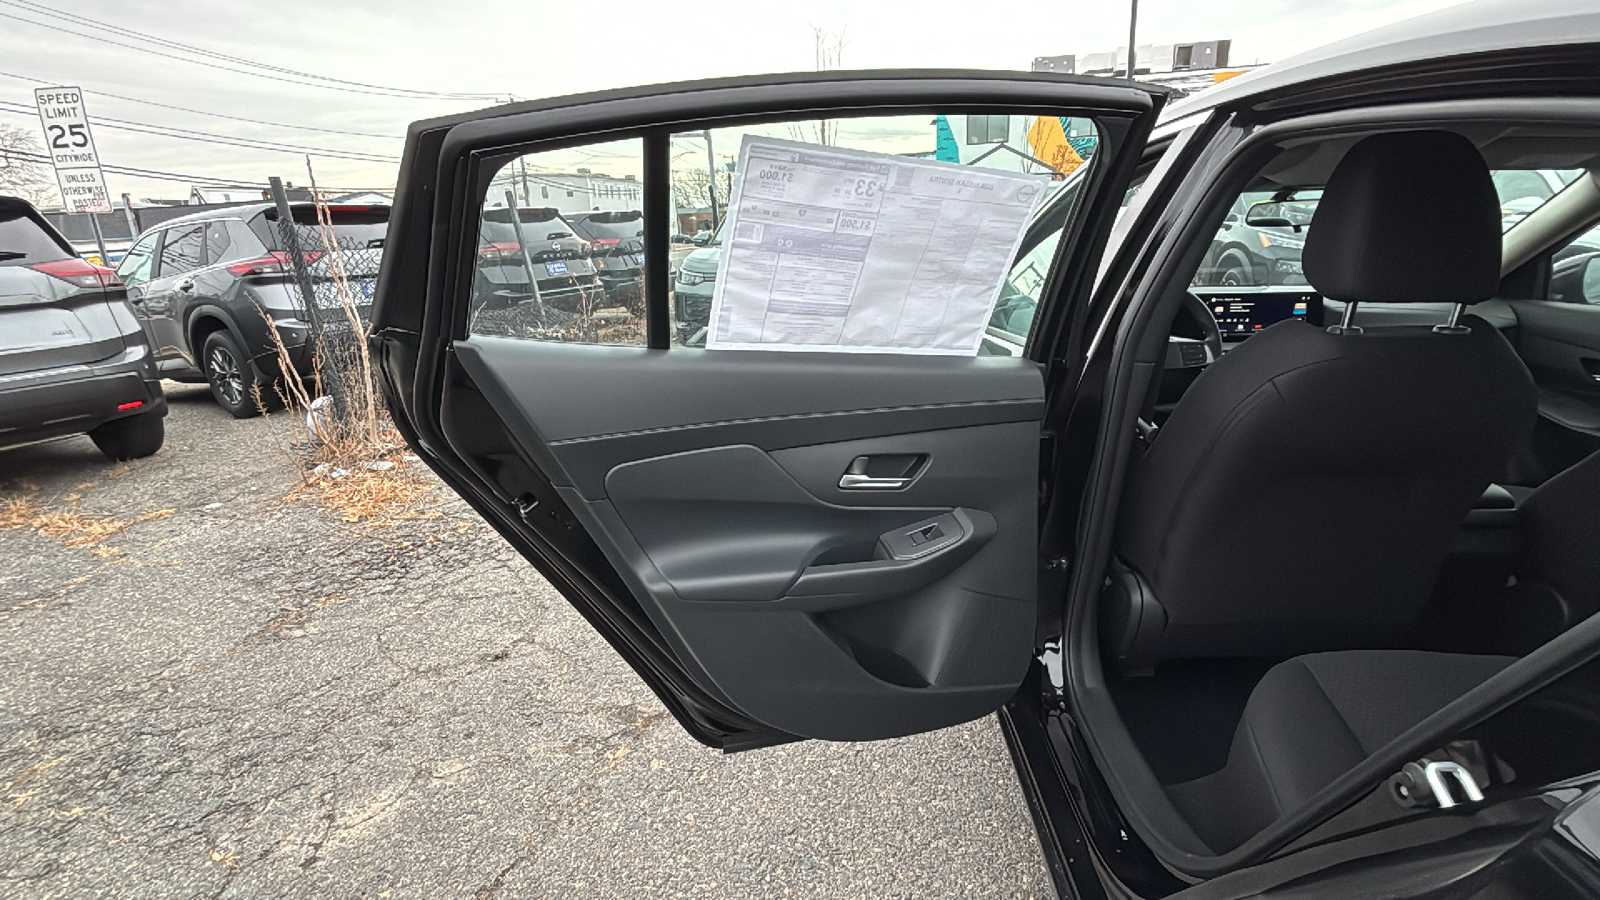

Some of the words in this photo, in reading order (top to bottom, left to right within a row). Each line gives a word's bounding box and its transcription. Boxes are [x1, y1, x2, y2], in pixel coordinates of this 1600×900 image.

[38, 93, 79, 105] SPEED
[45, 107, 78, 119] LIMIT
[48, 123, 89, 149] 25
[55, 153, 94, 163] CITYWIDE
[64, 173, 96, 184] UNLESS
[63, 185, 105, 197] OTHERWISE
[73, 198, 104, 208] POSTED
